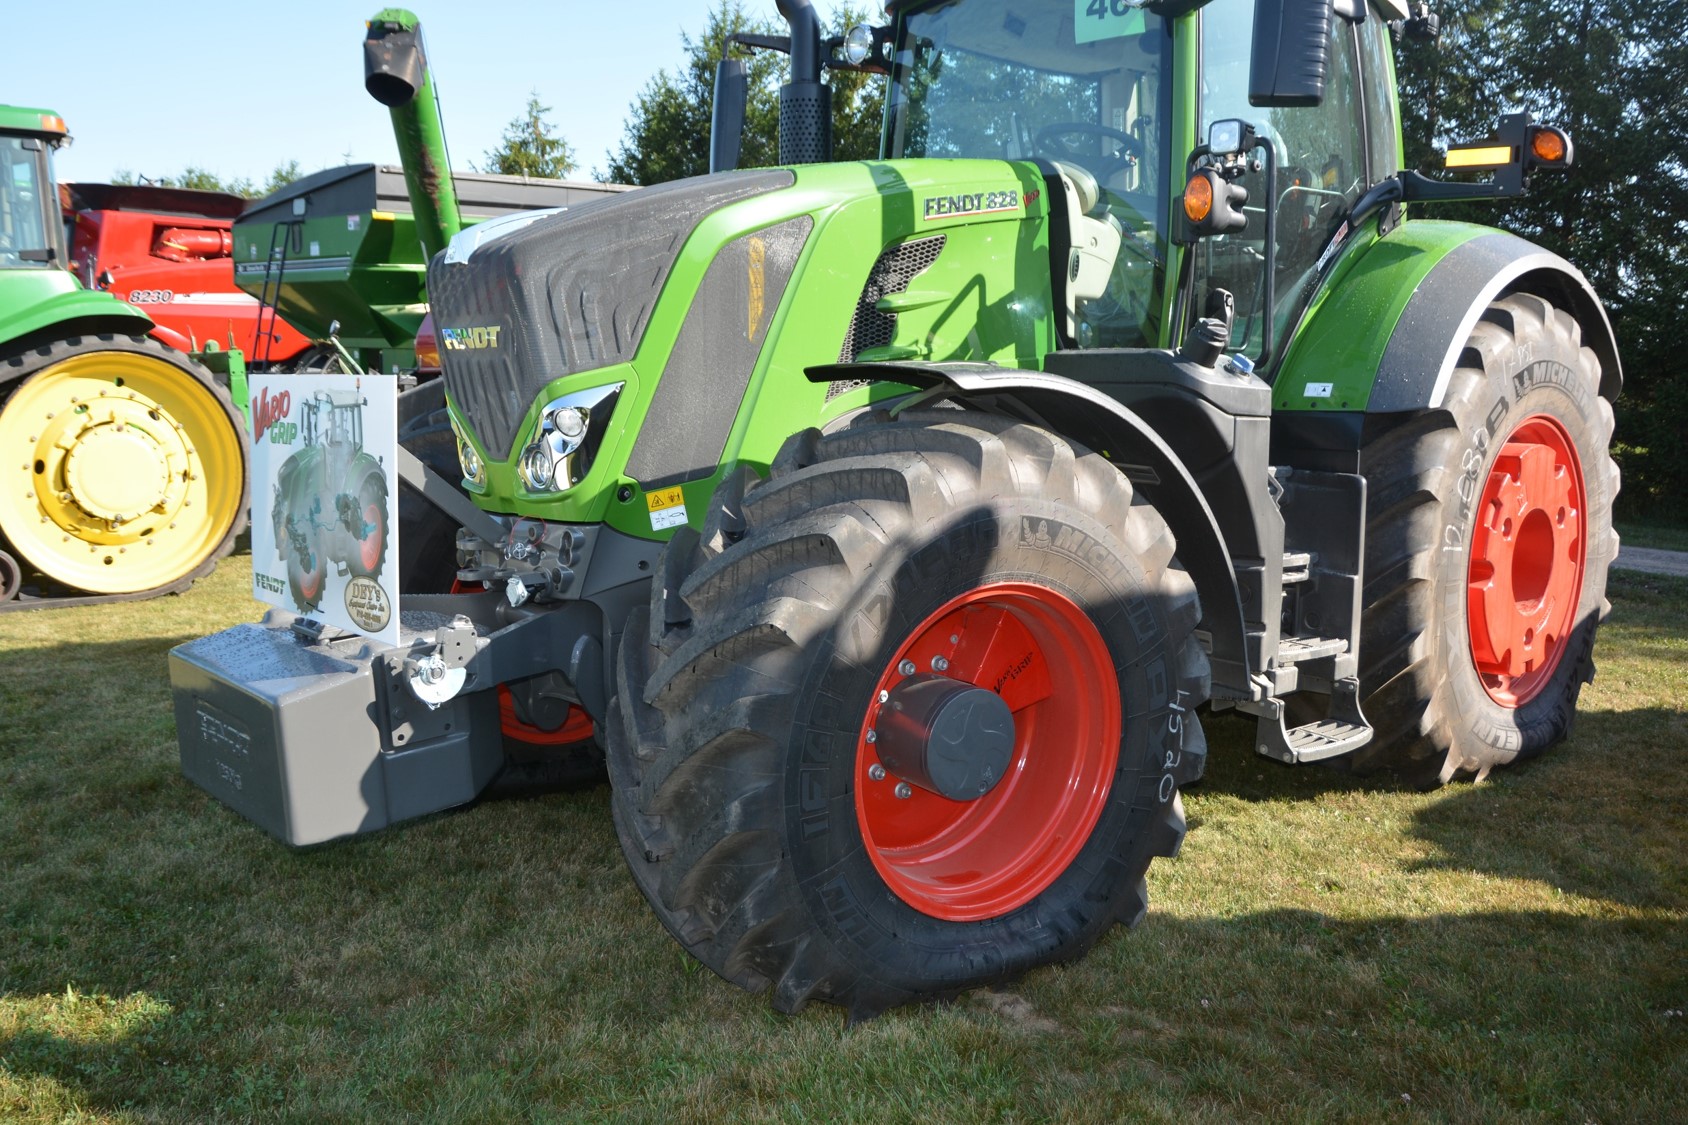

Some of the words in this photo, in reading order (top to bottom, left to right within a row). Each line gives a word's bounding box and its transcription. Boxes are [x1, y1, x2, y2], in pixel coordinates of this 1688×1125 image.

[925, 193, 984, 217] FENDT
[986, 189, 1018, 210] 828
[129, 290, 173, 303] 8230
[441, 326, 501, 350] FENDT
[270, 421, 297, 445] GRIP
[255, 572, 285, 595] FENDT
[1053, 523, 1158, 637] MICHELIN
[1160, 689, 1191, 803] 4520
